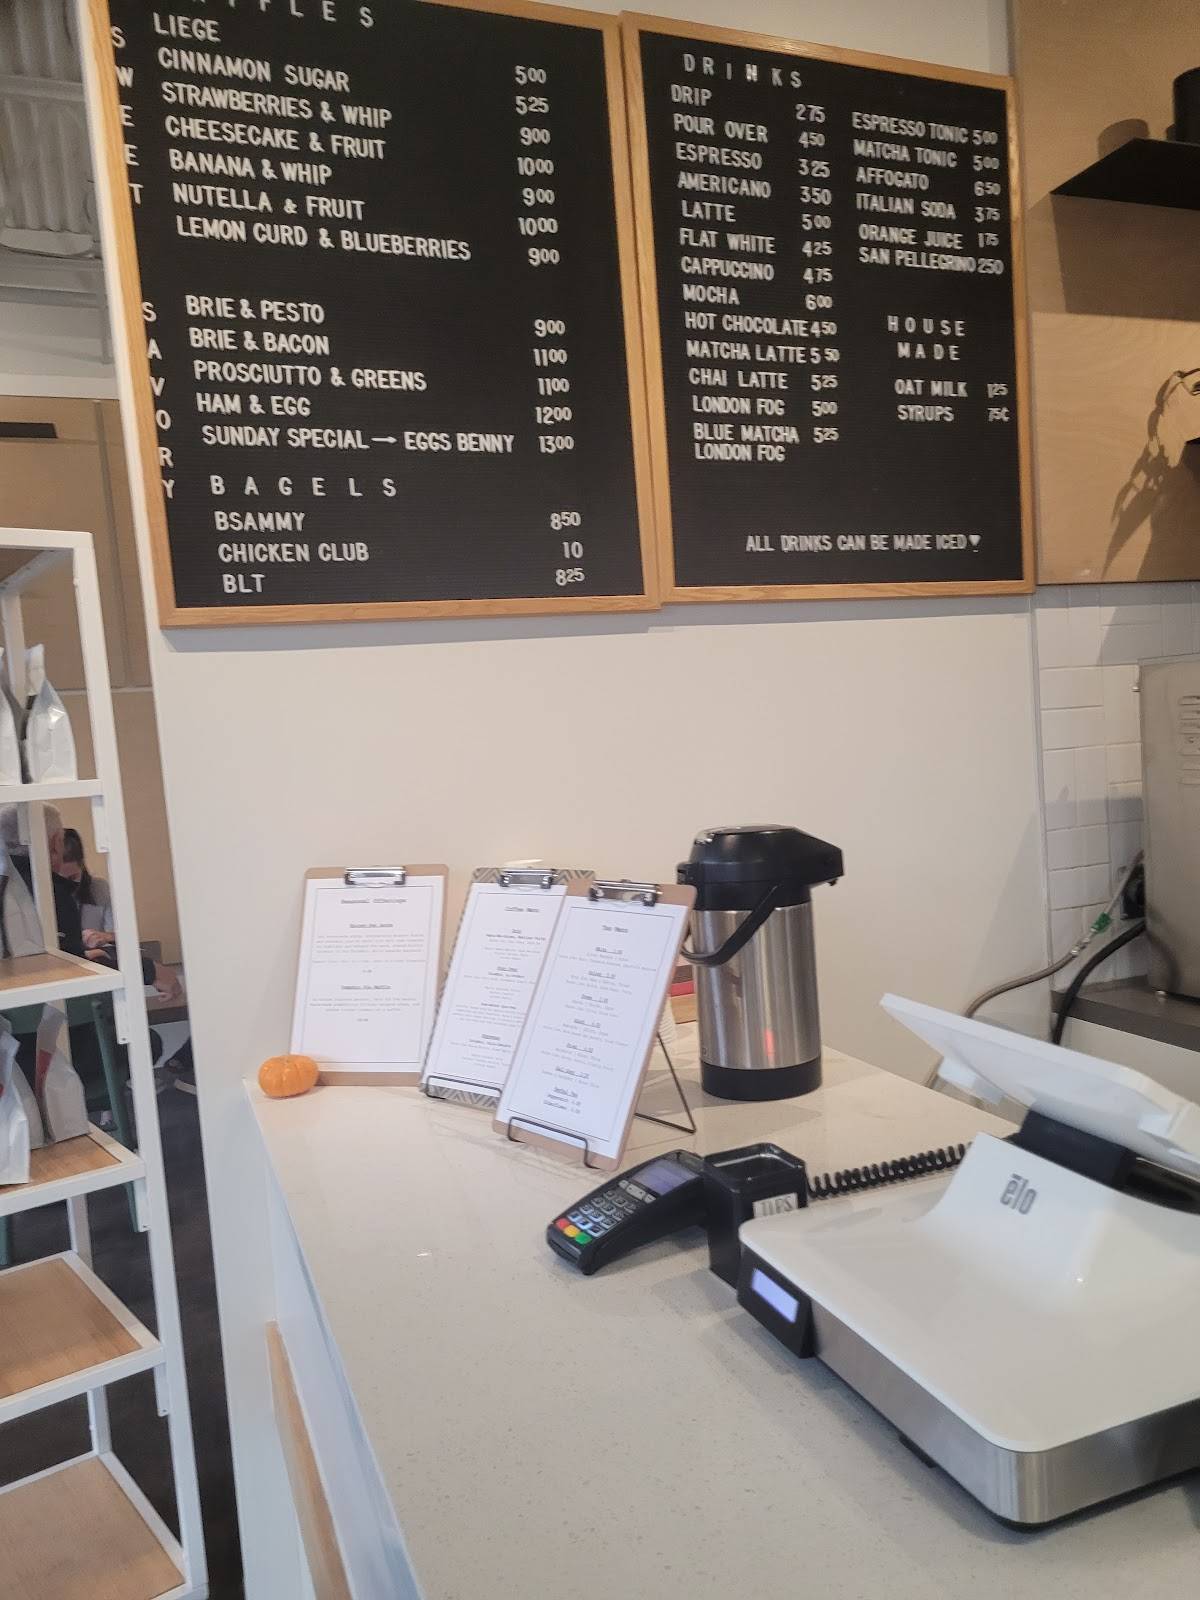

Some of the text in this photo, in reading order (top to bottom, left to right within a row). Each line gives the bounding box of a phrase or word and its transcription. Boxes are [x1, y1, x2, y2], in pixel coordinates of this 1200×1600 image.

[153, 13, 220, 41] LIEGE
[158, 47, 349, 92] CINNAMON SUGAR
[515, 66, 546, 85] 500
[684, 54, 801, 88] DRINKS
[671, 84, 712, 106] DRIP
[162, 82, 392, 128] STRAWBERRIES & WHIP
[516, 96, 549, 115] 525
[796, 104, 825, 123] 275
[165, 115, 385, 159] CHEESECAKE & FRUIT
[520, 127, 550, 145] 900
[674, 113, 768, 142] POUR OVER
[853, 112, 968, 143] ESPRESSO TONIC
[799, 132, 825, 148] 450
[972, 130, 997, 145] 500
[676, 142, 762, 169] ESPRESSO
[854, 139, 957, 167] MATCHA TONIC
[169, 149, 332, 186] BANANA & WHIP
[517, 157, 554, 176] 1000
[799, 159, 830, 177] 325
[973, 155, 999, 171] 500
[678, 171, 771, 198] AMERICANO
[856, 167, 929, 190] AFFOCATO
[523, 188, 555, 206] 900
[800, 186, 831, 205] 350
[975, 181, 1000, 196] 650
[173, 183, 365, 220] NUTELLA & FRUIT
[682, 200, 736, 222] LATTE
[857, 193, 956, 219] ITALIAN SODA
[802, 214, 831, 230] 500
[975, 207, 1000, 222] 375
[518, 217, 558, 236] 1000
[177, 215, 471, 260] LEMON CURD & BLUEBERRIES
[680, 228, 776, 254] FLAT WHITE
[859, 224, 963, 249] ORANGE JUICE
[978, 233, 999, 247] 175
[528, 248, 559, 266] 900
[802, 241, 832, 257] 425
[681, 256, 774, 280] CAPPUCCINO
[859, 247, 976, 272] SAN PELLEGRINO
[978, 258, 1003, 274] 250
[803, 268, 832, 284] 475
[683, 284, 740, 304] MOCHA
[805, 295, 832, 310] 600
[186, 295, 324, 323] BRIE & PESTO
[535, 319, 565, 337] 900
[685, 312, 809, 336] HOT CHOCOLATE
[810, 322, 837, 337] 450
[888, 316, 965, 336] HOUSE
[189, 327, 329, 355] BRIE & BACON
[533, 349, 567, 366] 1100
[687, 340, 806, 363] MATCHA LATTE
[898, 342, 960, 360] MADE
[194, 360, 426, 390] PROSCIUTTO & GREENS
[689, 368, 788, 389] CHAI LATTE
[811, 375, 838, 391] 525
[538, 378, 569, 395] 1100
[895, 379, 967, 397] OAT MILK
[987, 384, 1008, 398] 125
[196, 393, 310, 416] HAM & EGG
[693, 395, 785, 415] LONDON FOG
[812, 401, 837, 416] 500
[898, 405, 954, 421] SYRUPS
[536, 407, 572, 425] 1200
[202, 425, 514, 453] SUNDAY SPECIAL EGGS BENNY
[694, 423, 799, 443] BLUE MATCHA
[813, 427, 839, 443] 525
[539, 436, 574, 453] 1300
[695, 443, 785, 461] LONDON FOG
[210, 475, 396, 496] BAGELS
[551, 512, 581, 530] 850
[563, 542, 583, 558] 10
[746, 534, 967, 552] ALL DRINKS CAN BE MADE ICED
[218, 543, 369, 563] CHICKEN CLUB
[223, 574, 265, 593] BLT
[556, 568, 584, 586] 825
